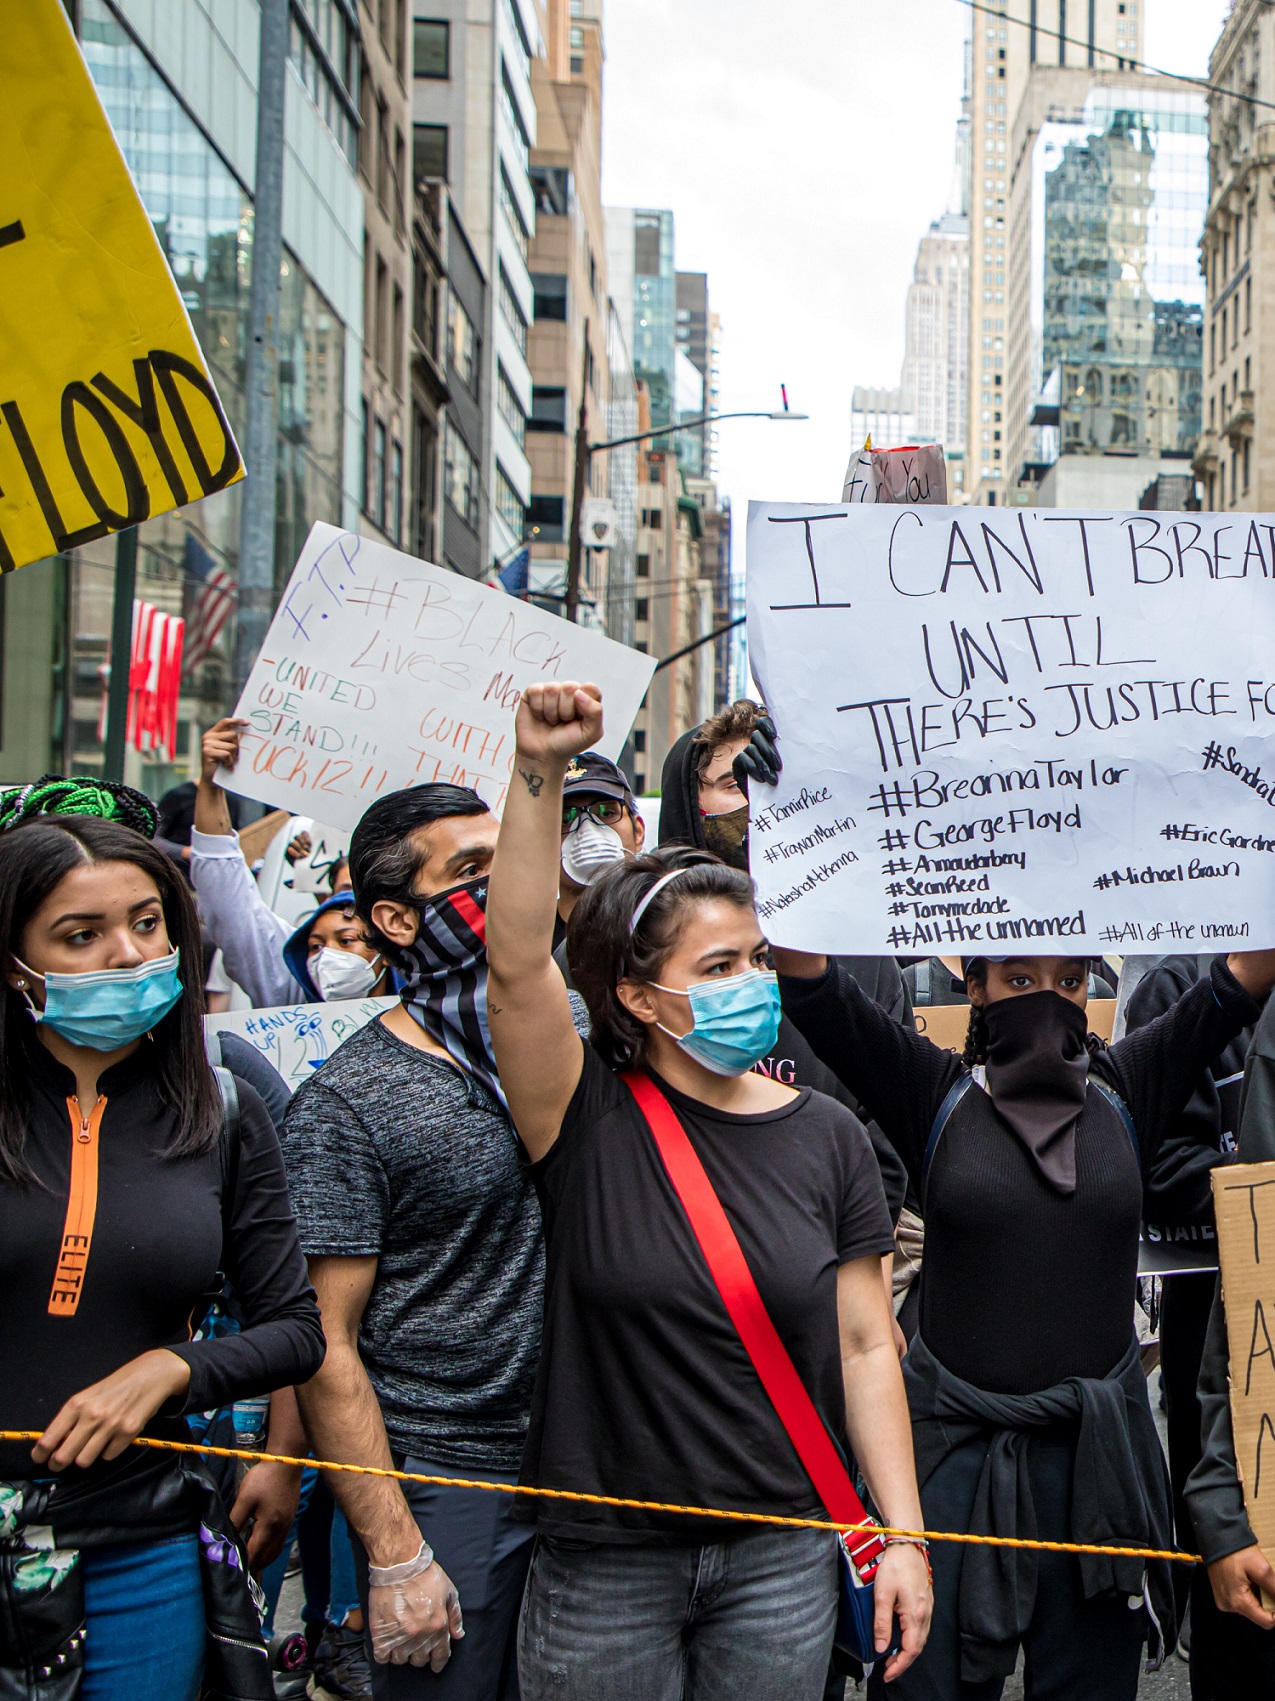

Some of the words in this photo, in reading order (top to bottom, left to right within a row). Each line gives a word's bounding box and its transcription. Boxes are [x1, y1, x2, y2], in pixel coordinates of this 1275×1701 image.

[768, 513, 851, 610] I
[888, 510, 1113, 597] CAN'T
[921, 613, 1157, 699] UNTIL
[258, 682, 304, 713] WE
[837, 696, 1036, 773] THERE'S
[1044, 678, 1236, 737] JUSTICE
[419, 707, 506, 767] WITH
[244, 1005, 308, 1036] HANDS
[253, 1032, 277, 1052] UP
[51, 1234, 88, 1304] ELITE
